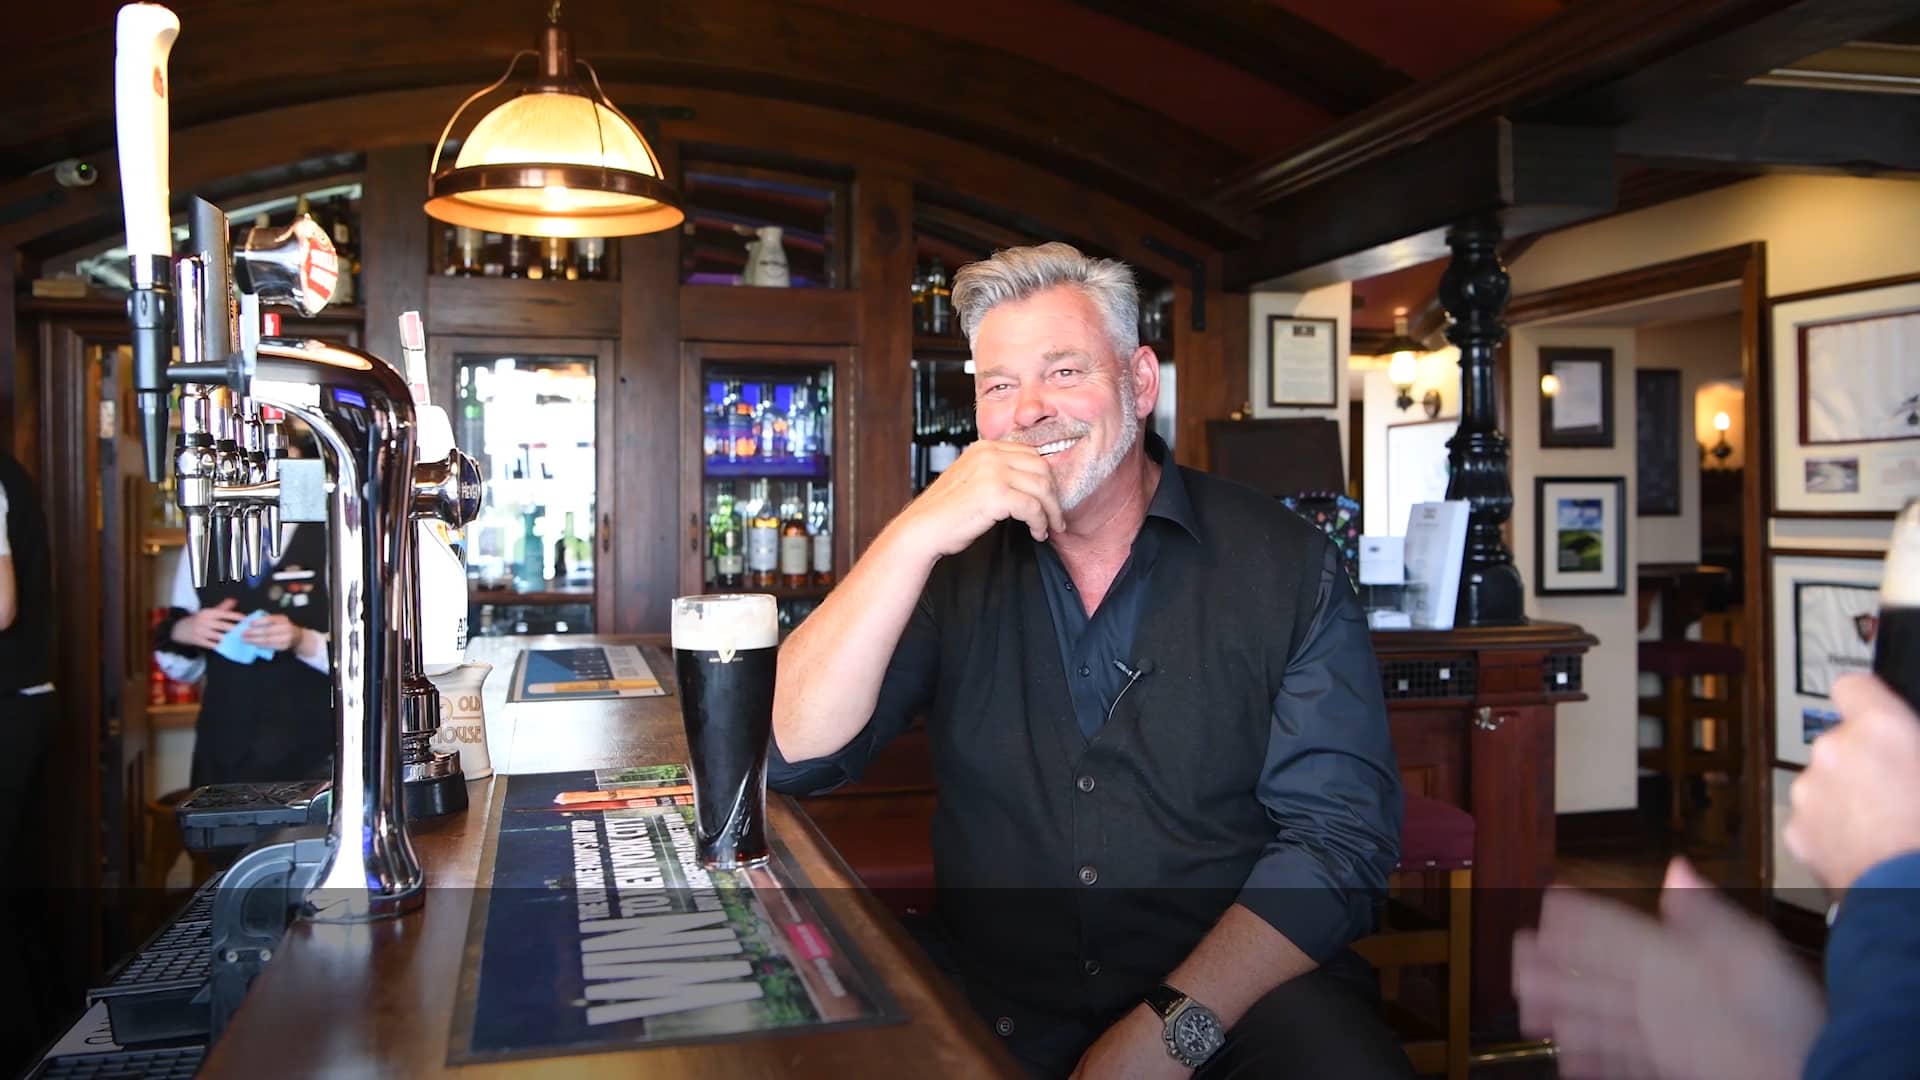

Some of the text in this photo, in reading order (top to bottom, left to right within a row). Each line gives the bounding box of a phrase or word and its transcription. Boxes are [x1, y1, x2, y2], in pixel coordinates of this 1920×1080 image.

[575, 869, 608, 903] ULTIMATE
[603, 817, 672, 918] TO NEW YORK CITY
[578, 901, 610, 920] THE
[579, 910, 764, 1026] WIN
